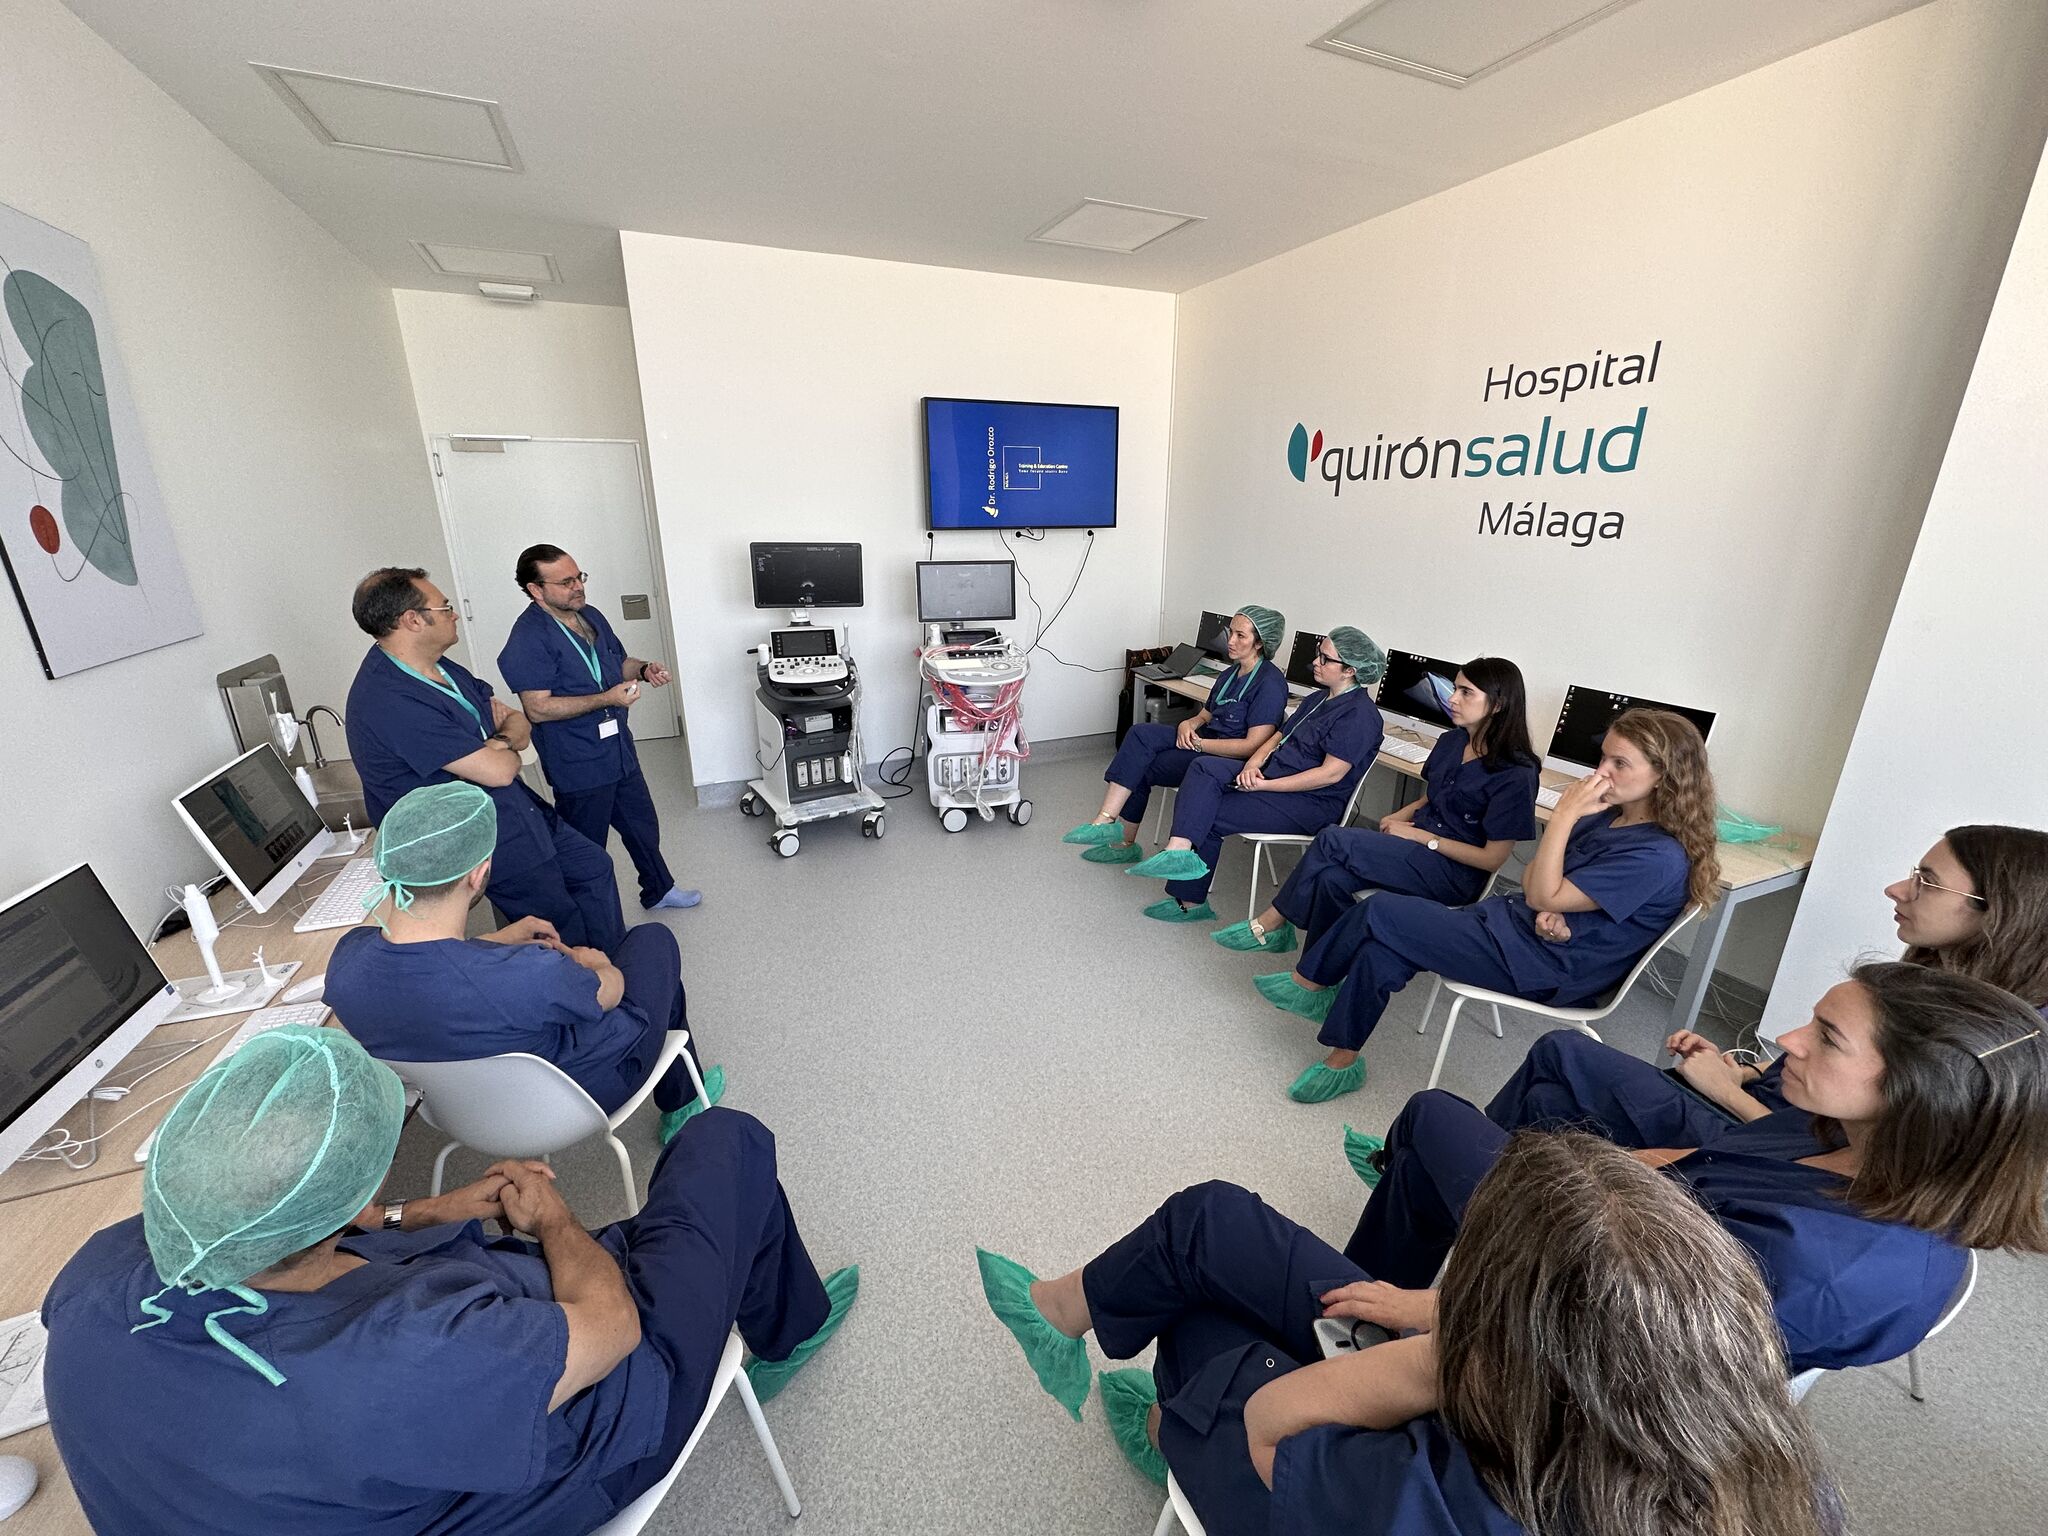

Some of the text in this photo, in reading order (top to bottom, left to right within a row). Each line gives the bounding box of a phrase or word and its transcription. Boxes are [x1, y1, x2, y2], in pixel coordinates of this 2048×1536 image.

[1483, 340, 1662, 402] Hospital
[987, 426, 996, 504] Dr. Rodrigo Orozco
[1321, 406, 1648, 497] quirónsalud
[1478, 501, 1625, 547] Málaga
